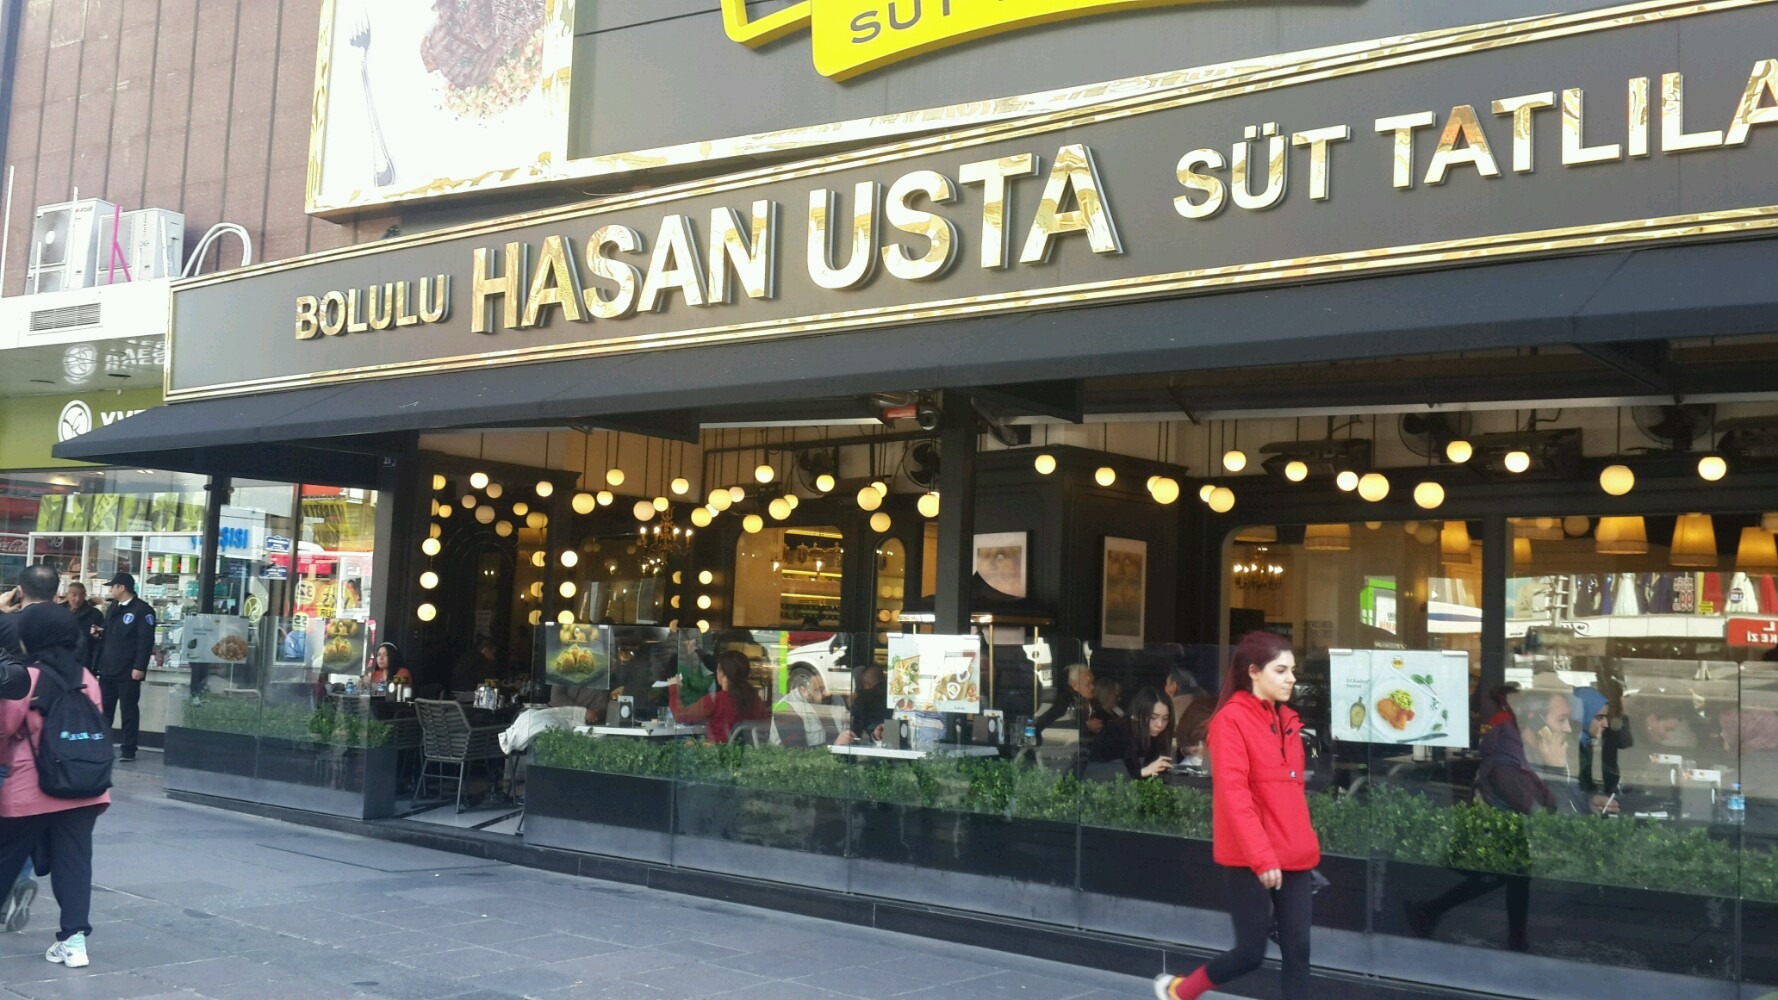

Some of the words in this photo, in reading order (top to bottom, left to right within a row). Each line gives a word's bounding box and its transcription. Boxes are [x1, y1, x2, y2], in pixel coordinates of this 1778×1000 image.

[294, 272, 452, 341] BOLULU
[470, 199, 779, 335] HASAN
[806, 144, 1123, 290] USTA
[1173, 121, 1351, 220] SÜT
